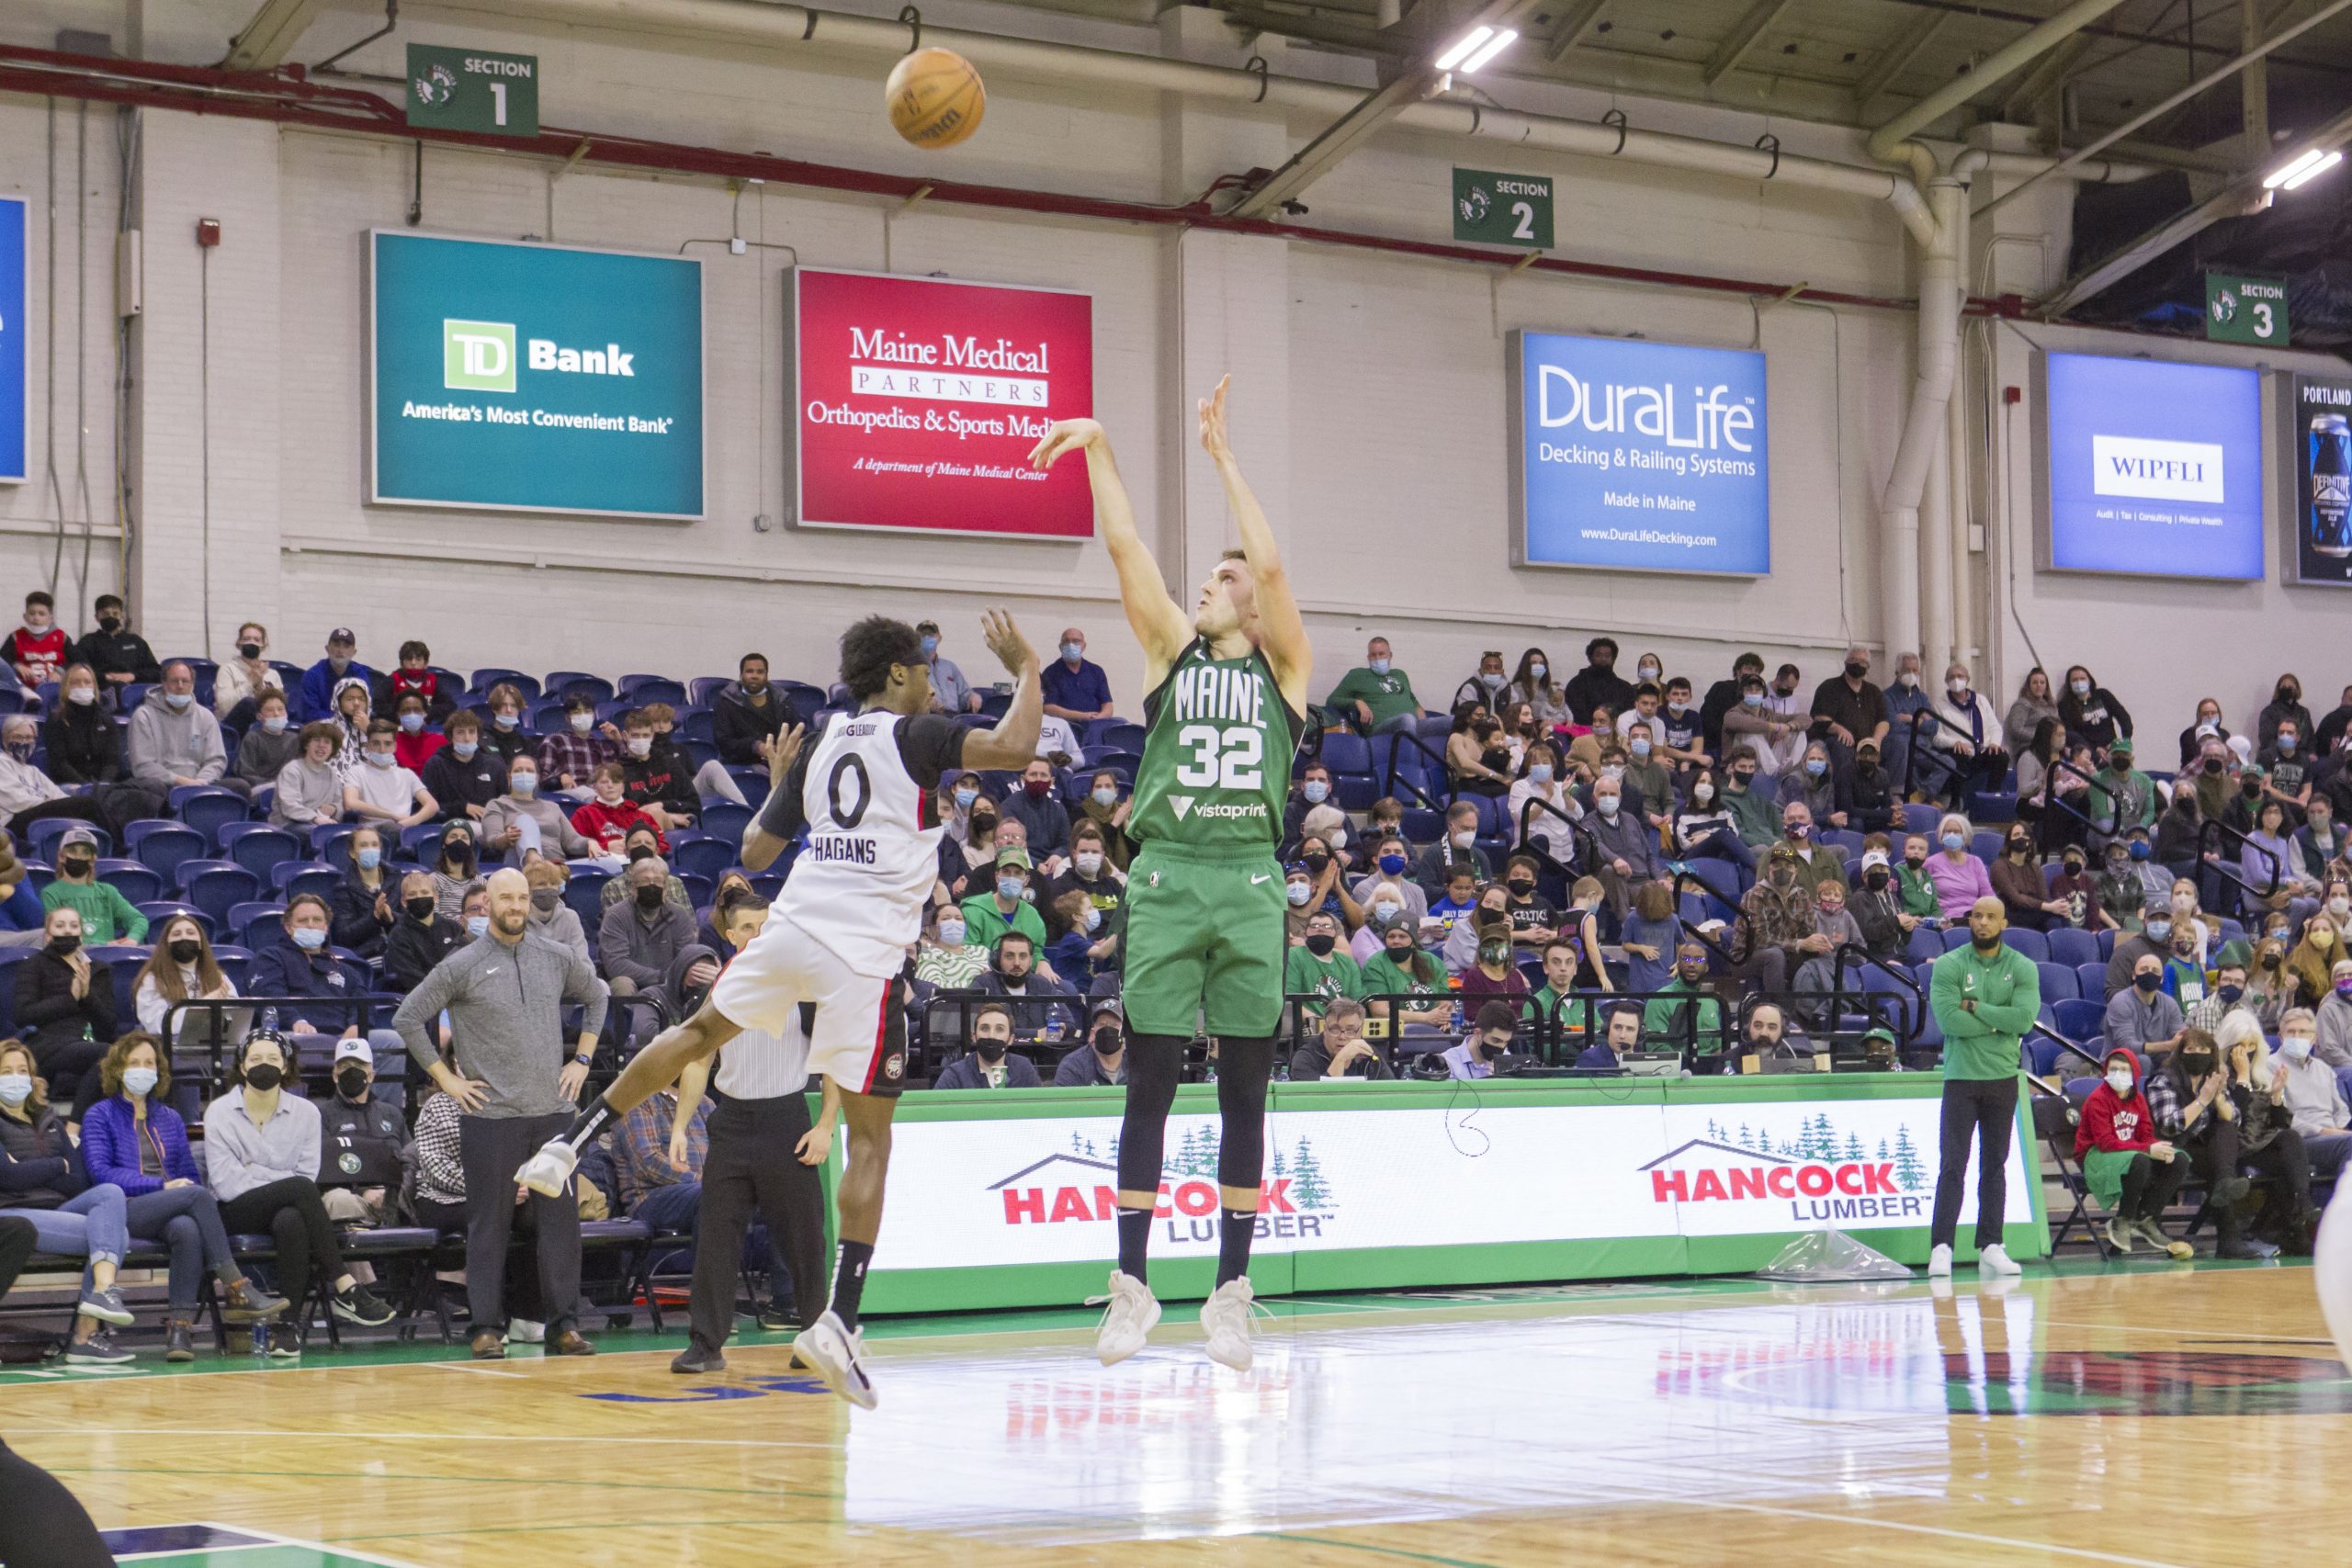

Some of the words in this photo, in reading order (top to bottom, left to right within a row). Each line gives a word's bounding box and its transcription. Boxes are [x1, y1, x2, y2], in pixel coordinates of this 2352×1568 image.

[464, 58, 532, 78] SECTION
[490, 82, 506, 126] 1
[1496, 180, 1548, 197] SECTION
[1511, 201, 1534, 239] 2
[2241, 283, 2283, 299] SECTION
[2253, 302, 2273, 338] 3
[452, 333, 508, 378] TD
[528, 338, 635, 377] Bank
[849, 327, 938, 366] Maine
[942, 333, 1049, 374] Medical
[857, 371, 1044, 402] PARTNERS
[2303, 386, 2352, 406] PORTLAND
[486, 405, 530, 425] Most
[531, 410, 627, 433] Convenient
[807, 400, 921, 434] Orthopedics
[923, 410, 947, 432] &
[948, 411, 1005, 440] Sports
[1007, 414, 1054, 440] Medi
[853, 457, 865, 470] A
[865, 459, 923, 477] department
[925, 462, 938, 478] of
[937, 462, 971, 478] Maine
[973, 467, 1013, 479] Medical
[1015, 467, 1048, 482] Center
[1539, 442, 1609, 471] Decking
[1613, 447, 1626, 468] &
[1630, 448, 1686, 476] Railing
[1690, 453, 1757, 478] Systems
[2110, 456, 2205, 483] WIPFLI
[1604, 491, 1640, 509] Made
[1643, 493, 1655, 510] in
[1657, 495, 1697, 513] Maine
[2096, 508, 2114, 520] Audit
[2120, 511, 2132, 521] Tax
[2138, 512, 2173, 525] Consulting
[2178, 514, 2200, 525] Private
[2200, 515, 2223, 526] Wealth
[1580, 527, 1717, 548] www.DuraLifeDecking.com
[1175, 665, 1268, 729] MAINE
[1176, 725, 1263, 790] 32
[828, 751, 872, 829] 0
[1194, 803, 1267, 819] vistaprint
[814, 836, 876, 864] HAGANS
[1651, 1163, 1900, 1202] HANCOCK
[1002, 1179, 1297, 1224] HANCOK
[1167, 1213, 1335, 1244] LUBER™
